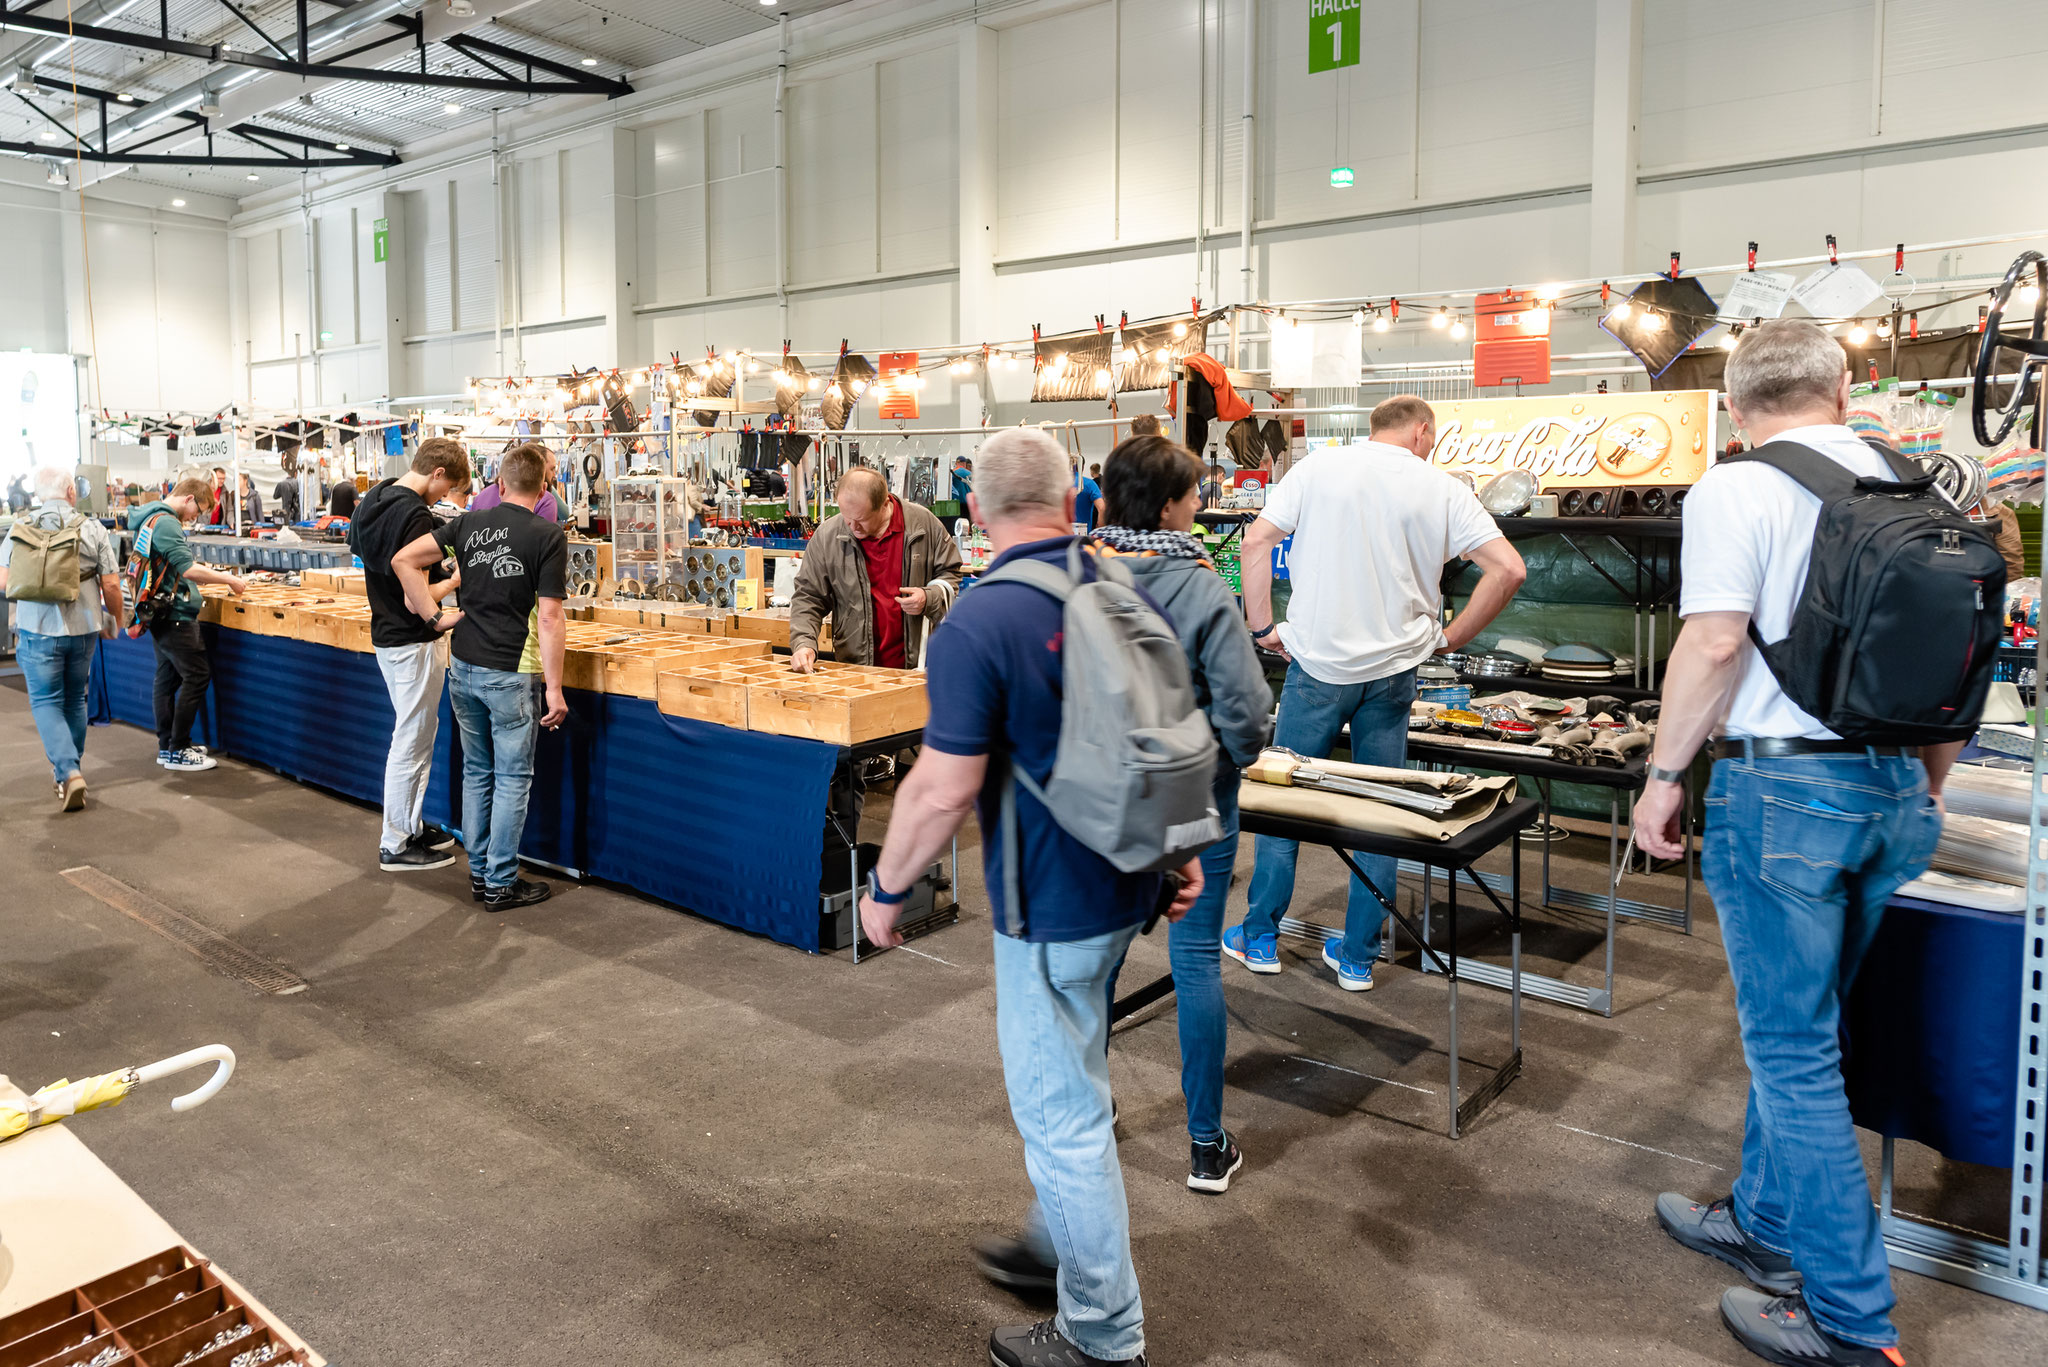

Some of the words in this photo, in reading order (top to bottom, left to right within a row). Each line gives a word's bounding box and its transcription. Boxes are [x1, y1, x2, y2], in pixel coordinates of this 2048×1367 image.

[1326, 21, 1342, 62] 1
[378, 236, 384, 258] 1
[190, 440, 228, 457] AUSGANG
[1430, 415, 1608, 477] Coca-Cola
[468, 544, 511, 567] Style
